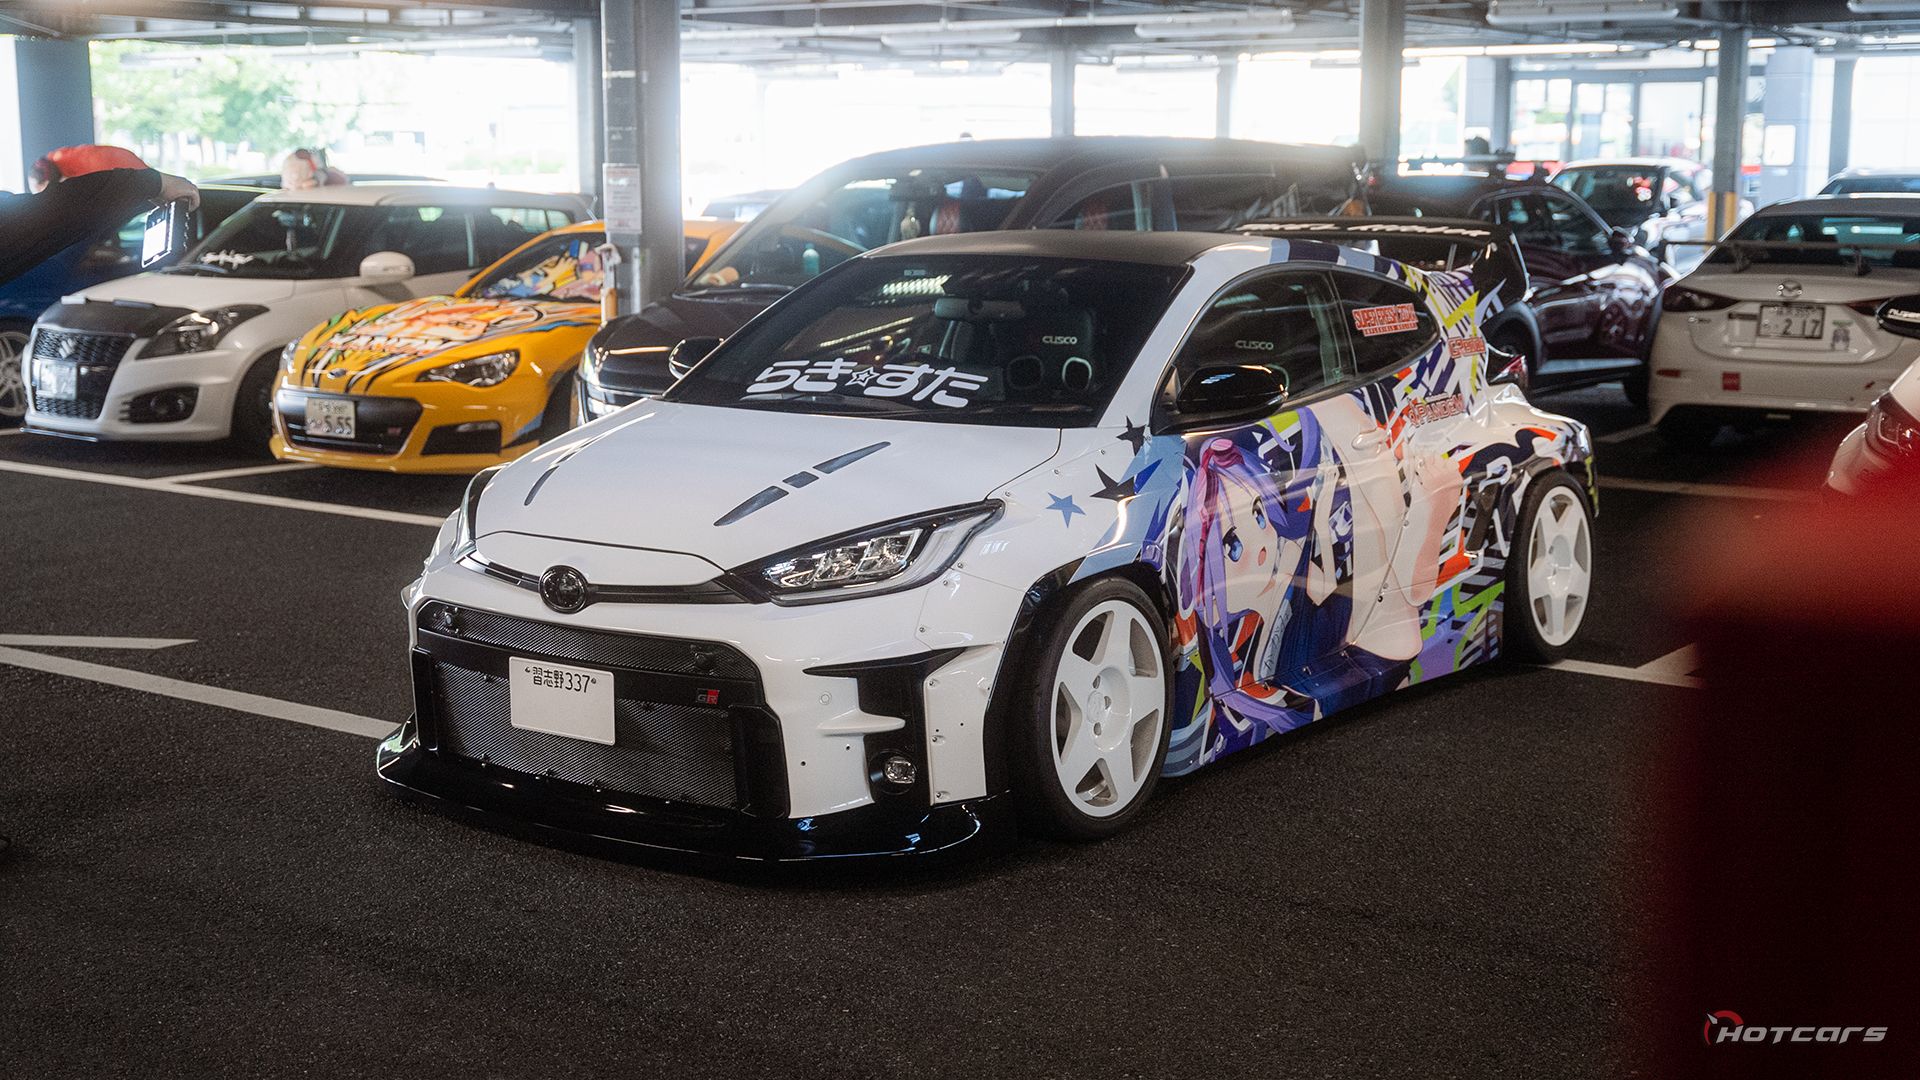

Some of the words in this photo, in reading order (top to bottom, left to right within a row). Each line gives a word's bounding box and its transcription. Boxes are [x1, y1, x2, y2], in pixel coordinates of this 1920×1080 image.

[1042, 335, 1078, 345] CUSCO
[1235, 340, 1274, 350] CUSCO
[697, 692, 719, 704] GR
